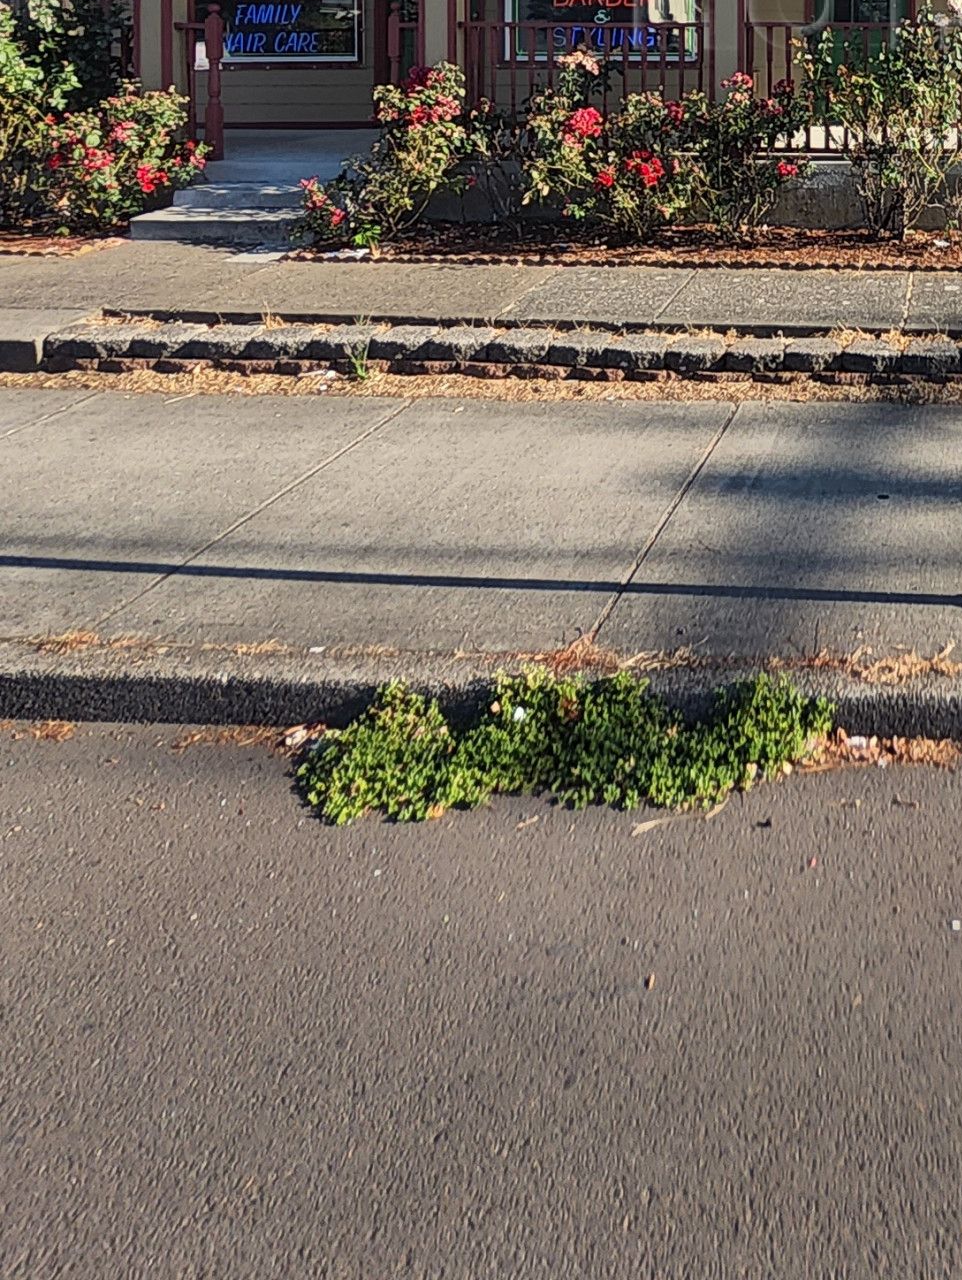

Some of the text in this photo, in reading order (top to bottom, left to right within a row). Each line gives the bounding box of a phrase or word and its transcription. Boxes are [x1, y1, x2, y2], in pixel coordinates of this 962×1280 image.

[234, 4, 302, 26] FAMILY
[593, 9, 611, 24] &
[274, 31, 320, 53] CARE
